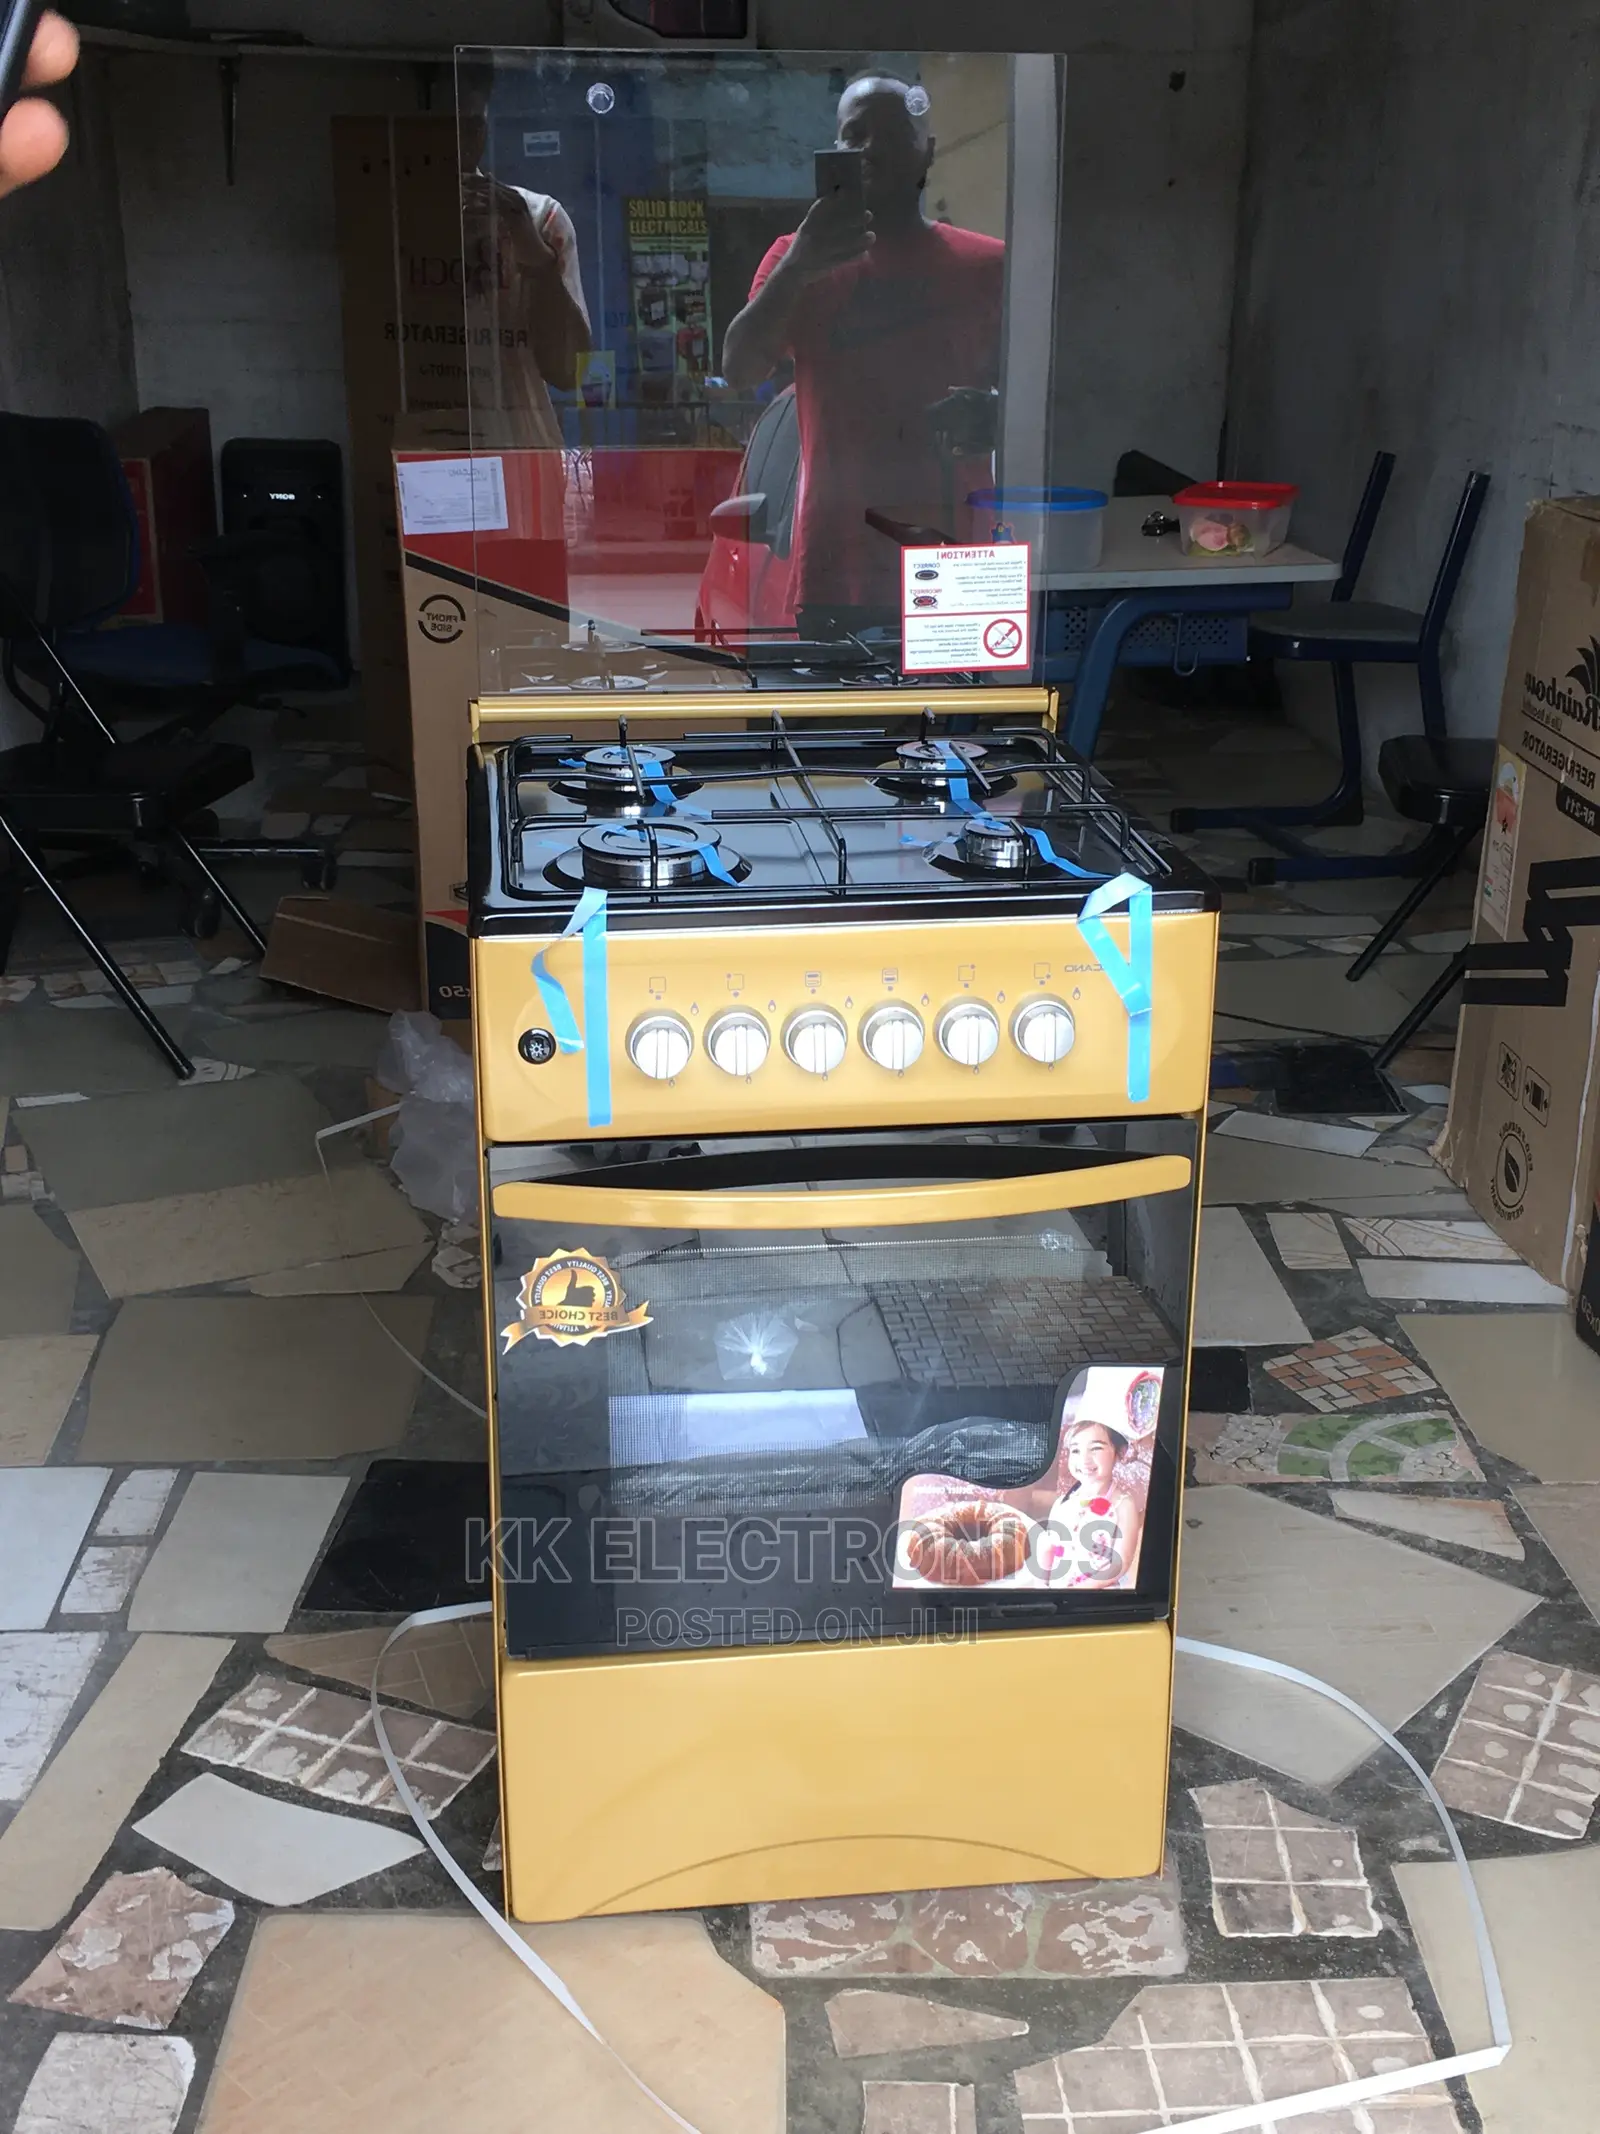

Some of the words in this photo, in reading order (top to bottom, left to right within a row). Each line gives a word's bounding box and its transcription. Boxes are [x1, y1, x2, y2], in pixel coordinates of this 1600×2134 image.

[628, 199, 666, 219] SOLID
[669, 200, 705, 219] ROCK
[629, 220, 708, 235] ELECTRICALS
